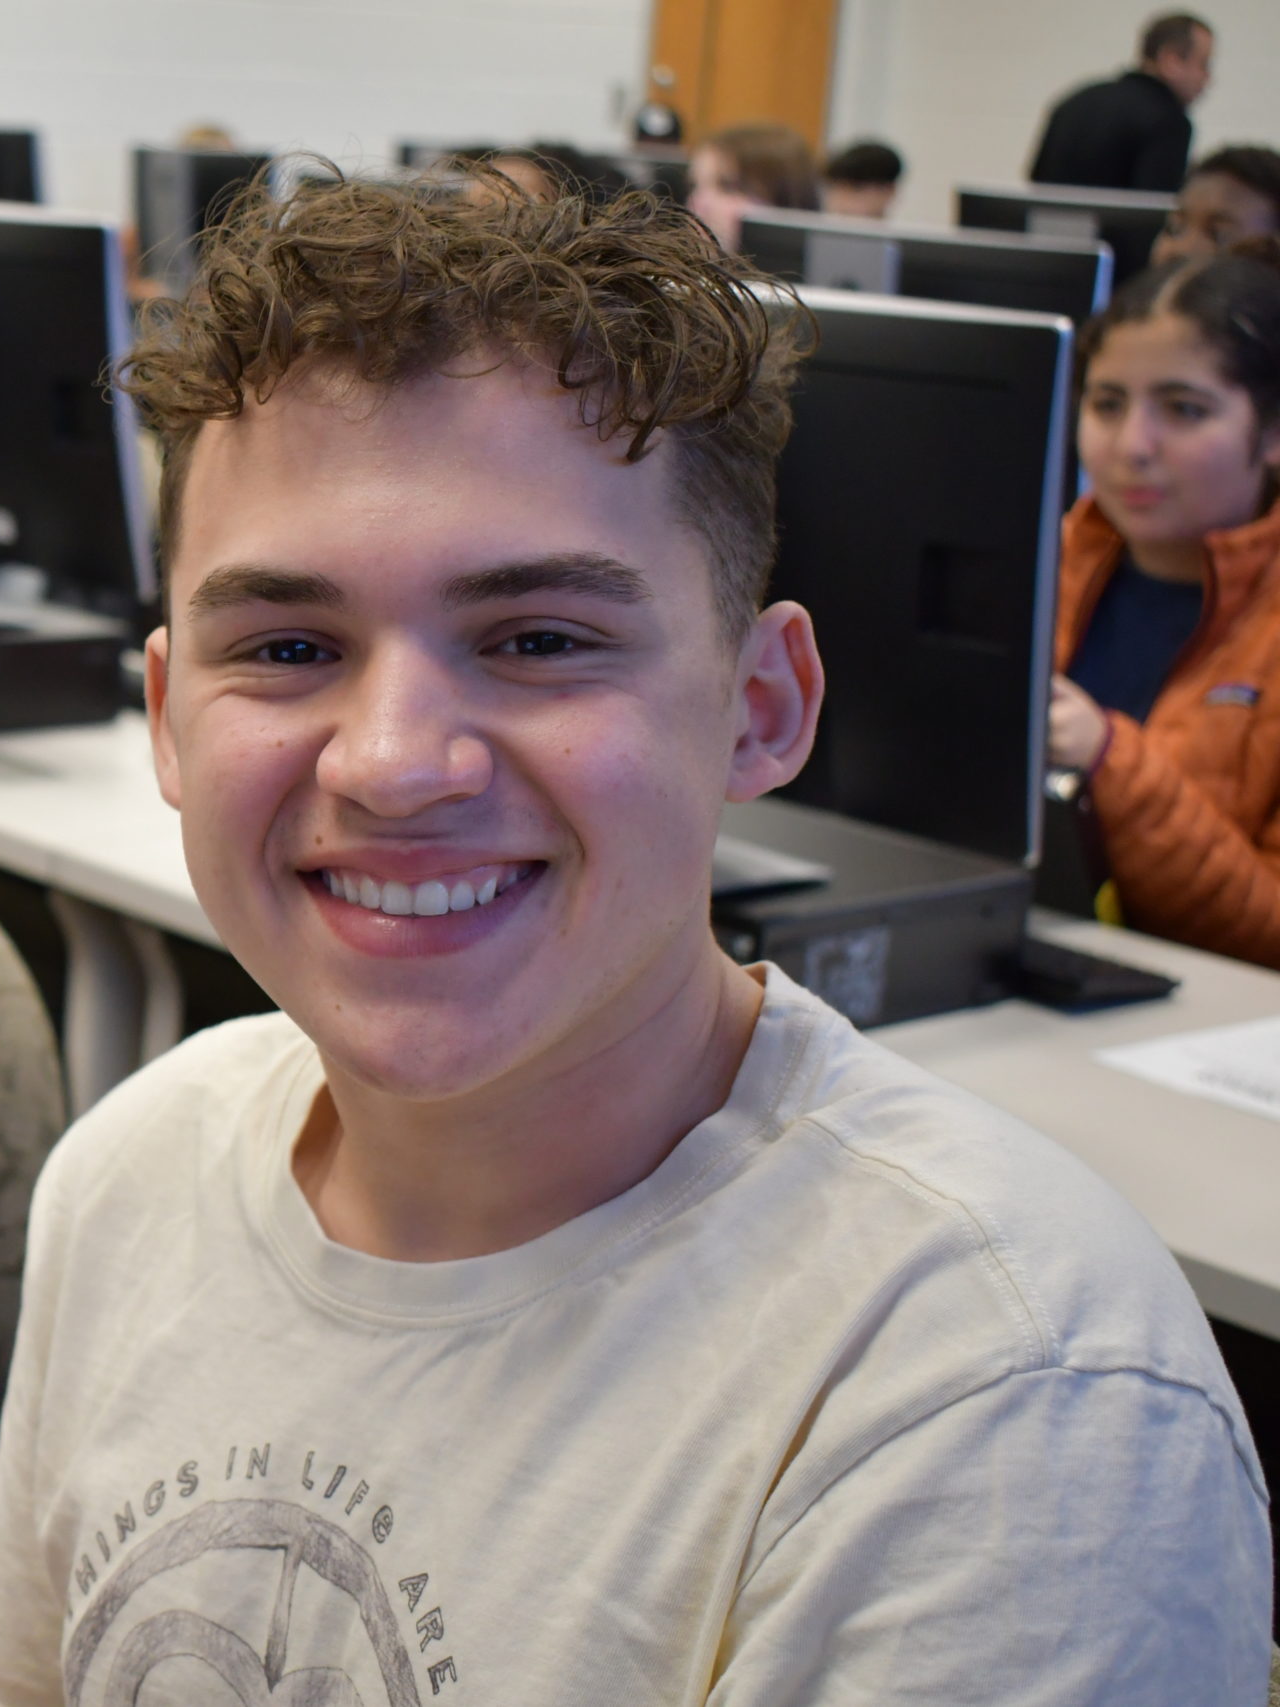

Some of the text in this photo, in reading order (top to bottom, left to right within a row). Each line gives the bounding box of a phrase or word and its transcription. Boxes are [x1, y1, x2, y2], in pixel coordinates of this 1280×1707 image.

[68, 1460, 199, 1621] HINGS
[225, 1443, 271, 1480] IN
[398, 1572, 458, 1696] ARE
